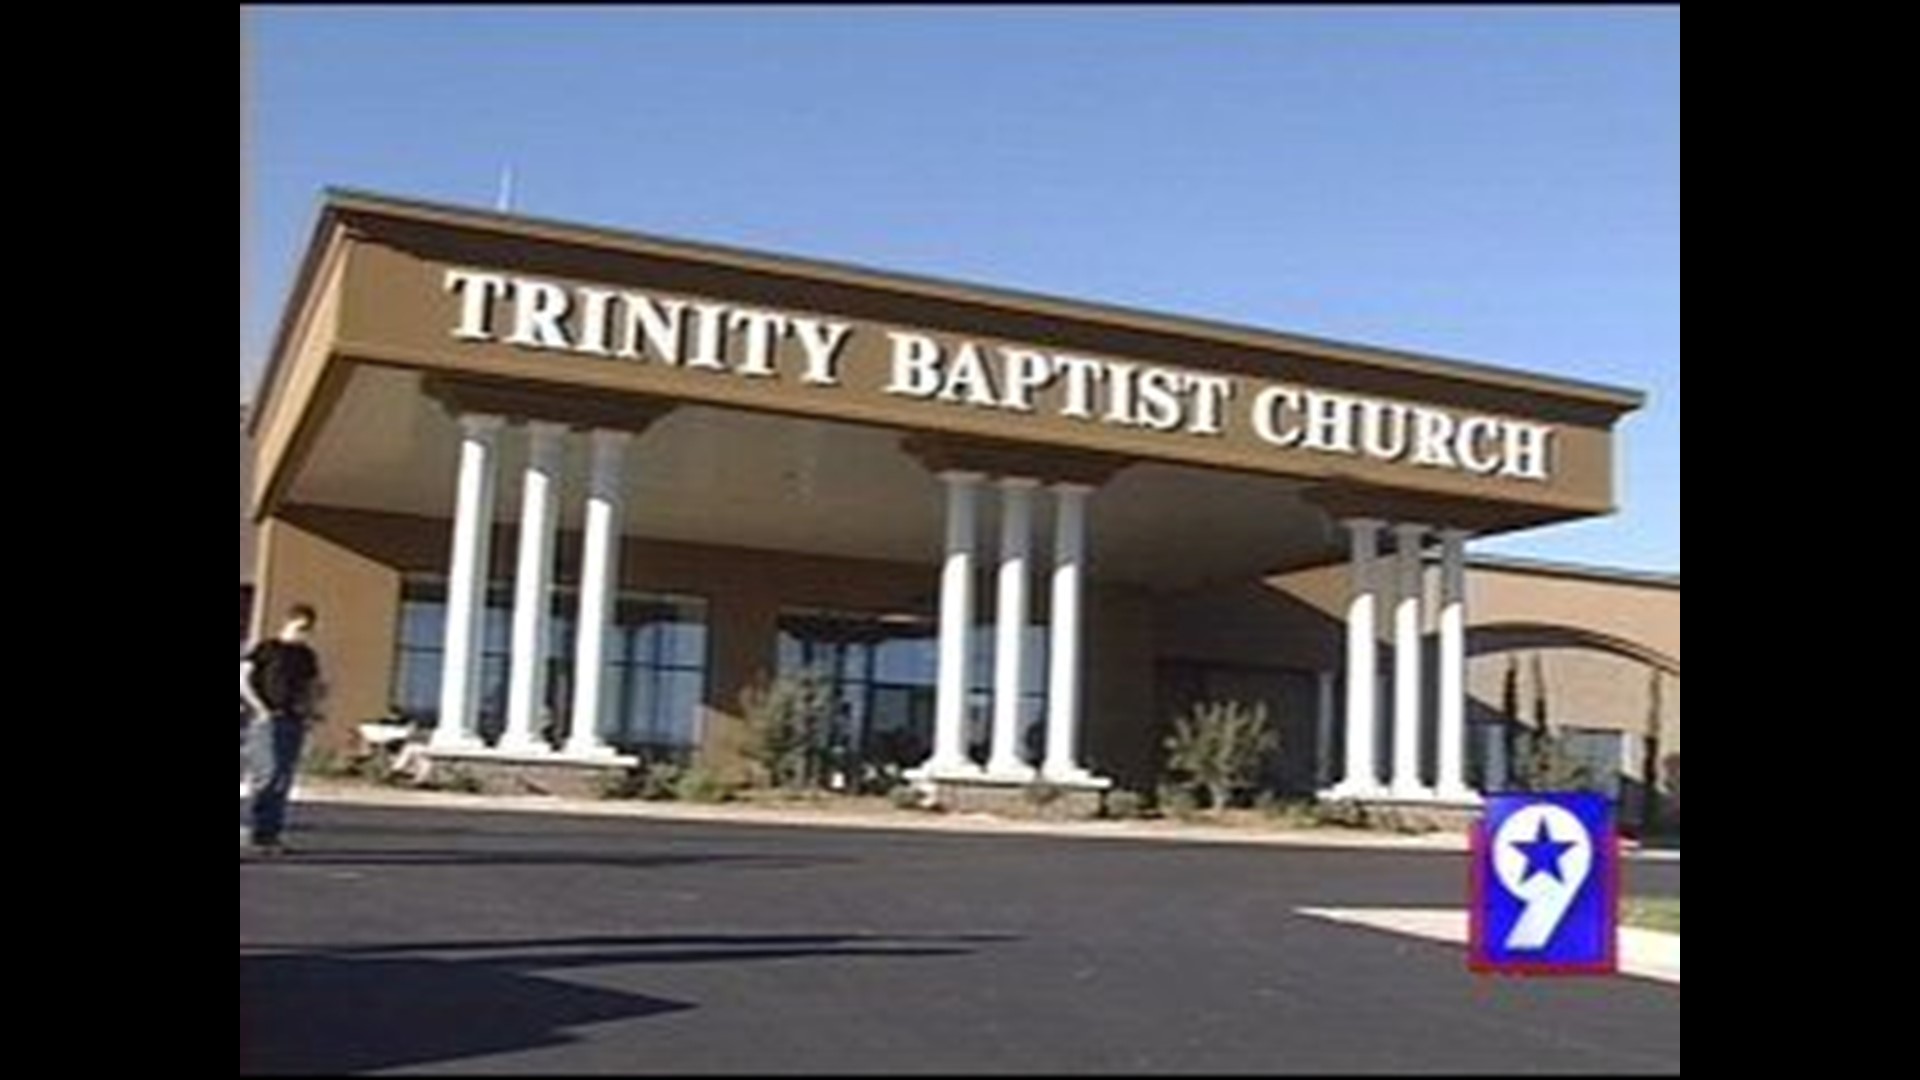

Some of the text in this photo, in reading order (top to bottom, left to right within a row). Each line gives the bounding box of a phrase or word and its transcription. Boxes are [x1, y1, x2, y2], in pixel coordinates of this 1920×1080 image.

[444, 268, 1552, 479] TRINITY BAPTIST CHURCH
